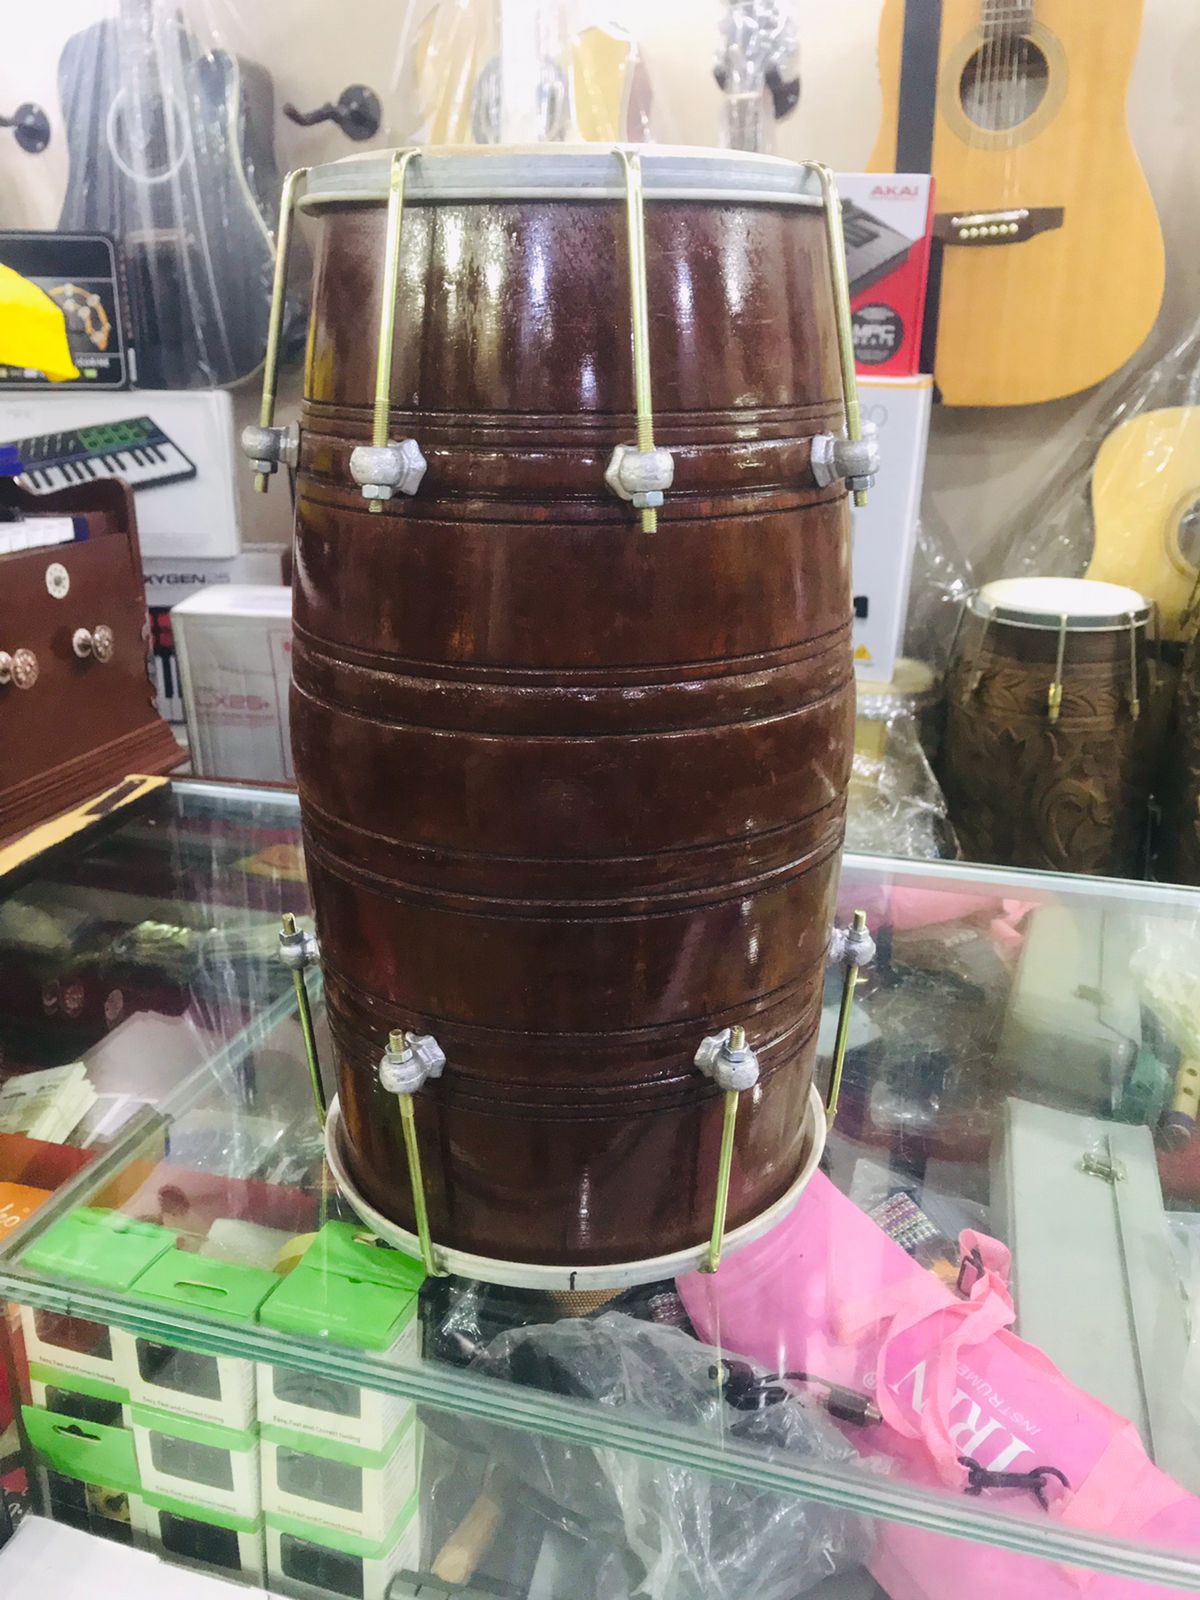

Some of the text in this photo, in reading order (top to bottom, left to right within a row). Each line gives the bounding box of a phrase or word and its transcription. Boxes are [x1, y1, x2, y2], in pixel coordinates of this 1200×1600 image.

[869, 186, 919, 196] AKAI
[144, 573, 206, 585] XYGEN
[955, 1362, 1041, 1436] INSTRUME
